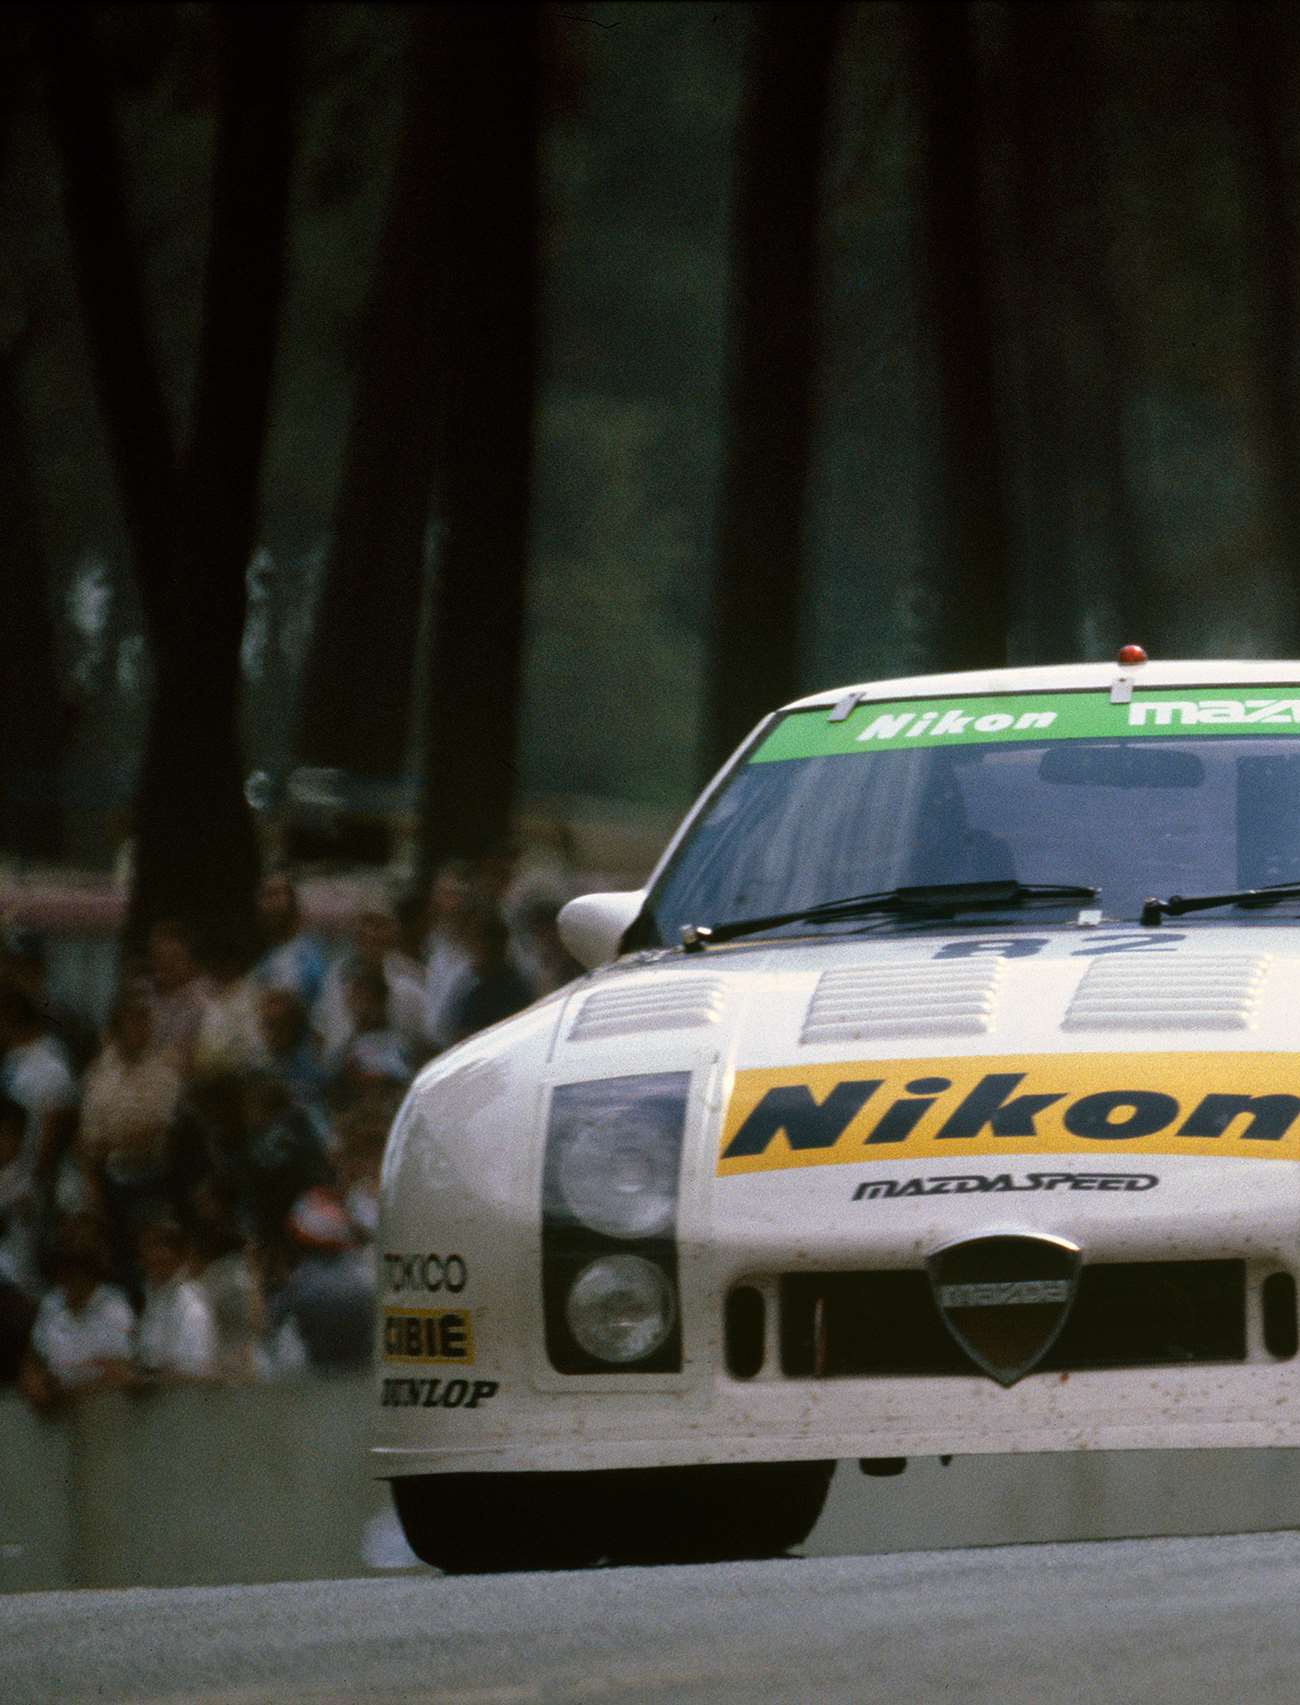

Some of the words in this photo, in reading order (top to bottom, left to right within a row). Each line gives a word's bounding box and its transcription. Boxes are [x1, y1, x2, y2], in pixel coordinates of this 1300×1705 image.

[856, 710, 1058, 741] Nikon
[931, 933, 1187, 960] 82
[852, 1172, 1159, 1200] MAZDASPEED
